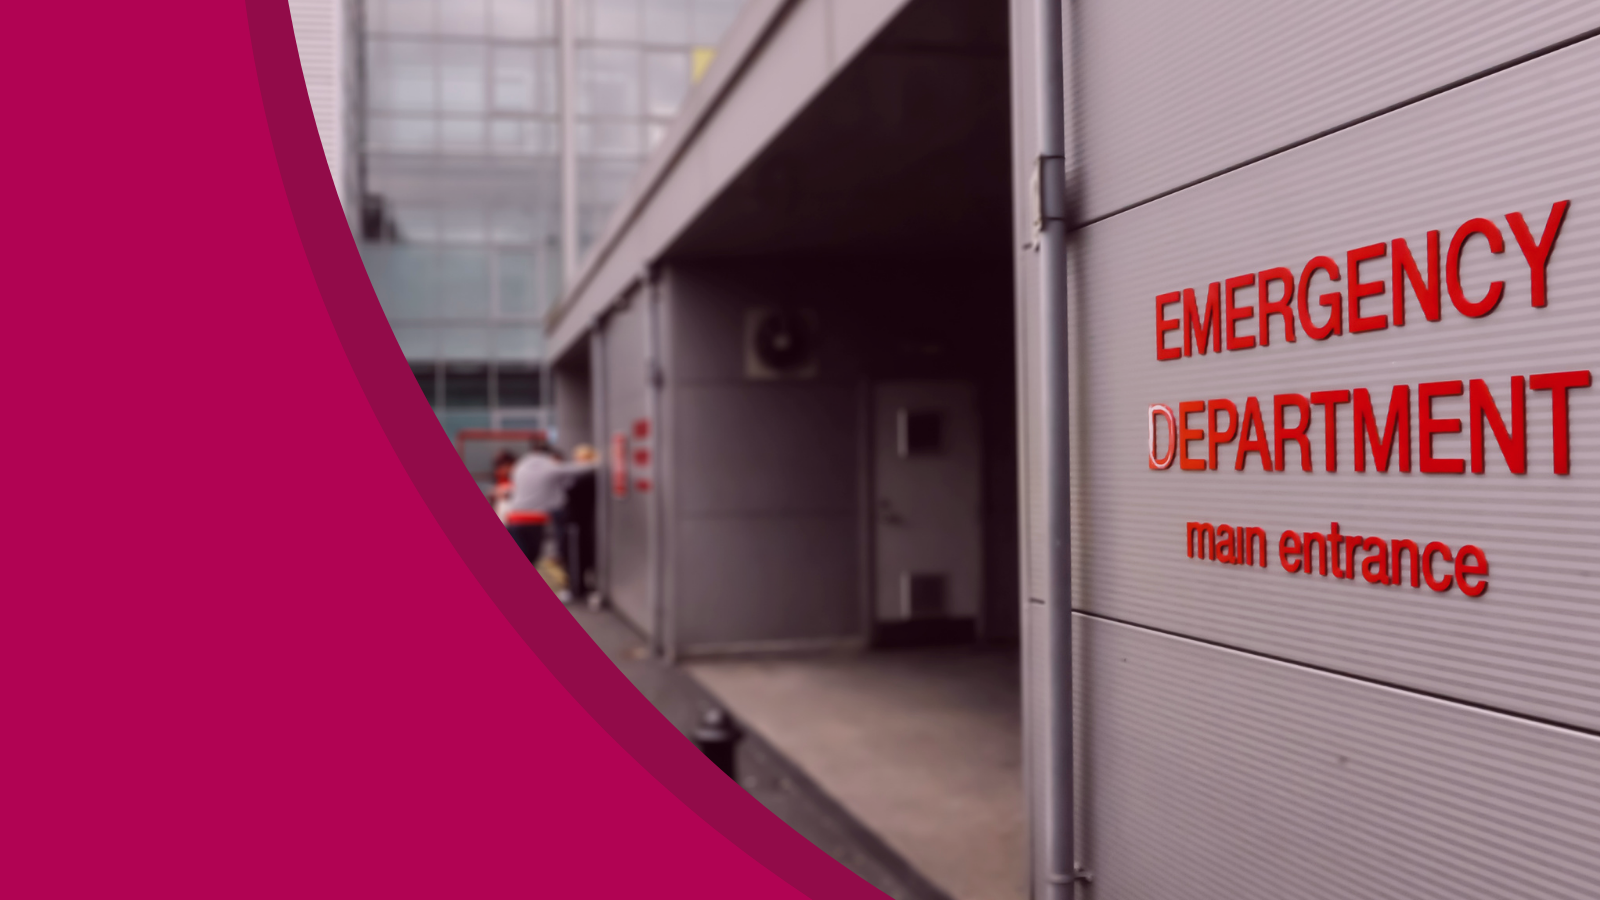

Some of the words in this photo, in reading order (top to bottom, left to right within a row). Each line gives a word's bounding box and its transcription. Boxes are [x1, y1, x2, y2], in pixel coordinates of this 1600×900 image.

[1155, 199, 1571, 362] EMERGENCY
[1148, 369, 1592, 476] DEPARTMENT
[1185, 521, 1268, 568] main
[1278, 521, 1489, 598] entrance
